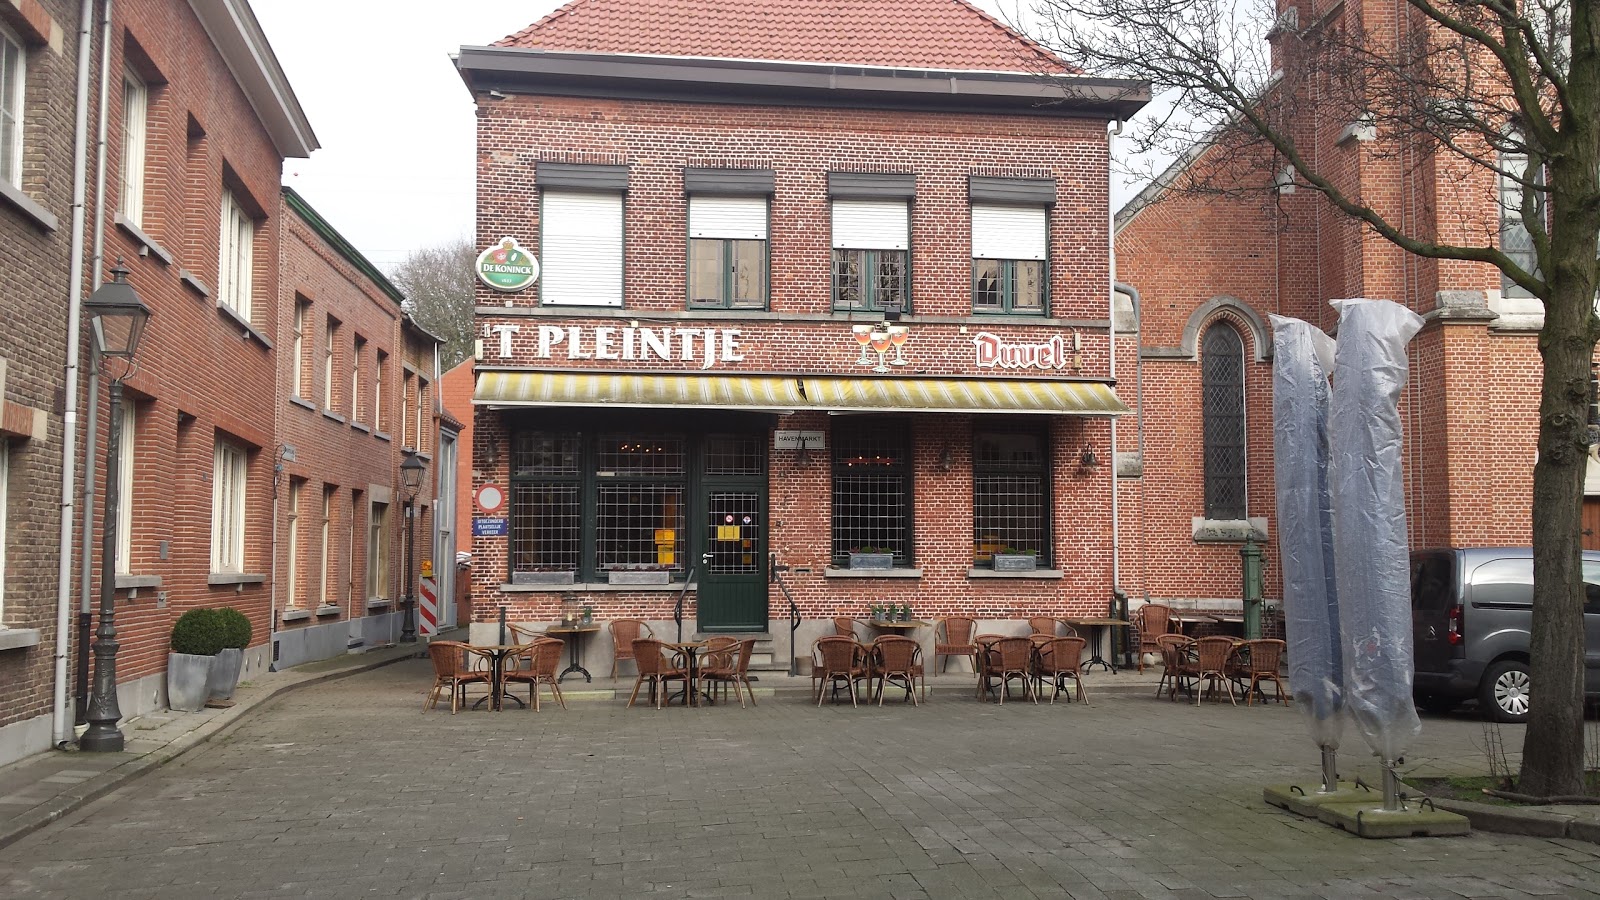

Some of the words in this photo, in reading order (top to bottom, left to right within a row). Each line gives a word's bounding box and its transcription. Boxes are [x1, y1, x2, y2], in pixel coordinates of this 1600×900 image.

[483, 263, 494, 272] DE
[495, 264, 532, 274] KONINCK
[538, 326, 744, 370] PLEINTJE
[974, 333, 1066, 368] Duvel
